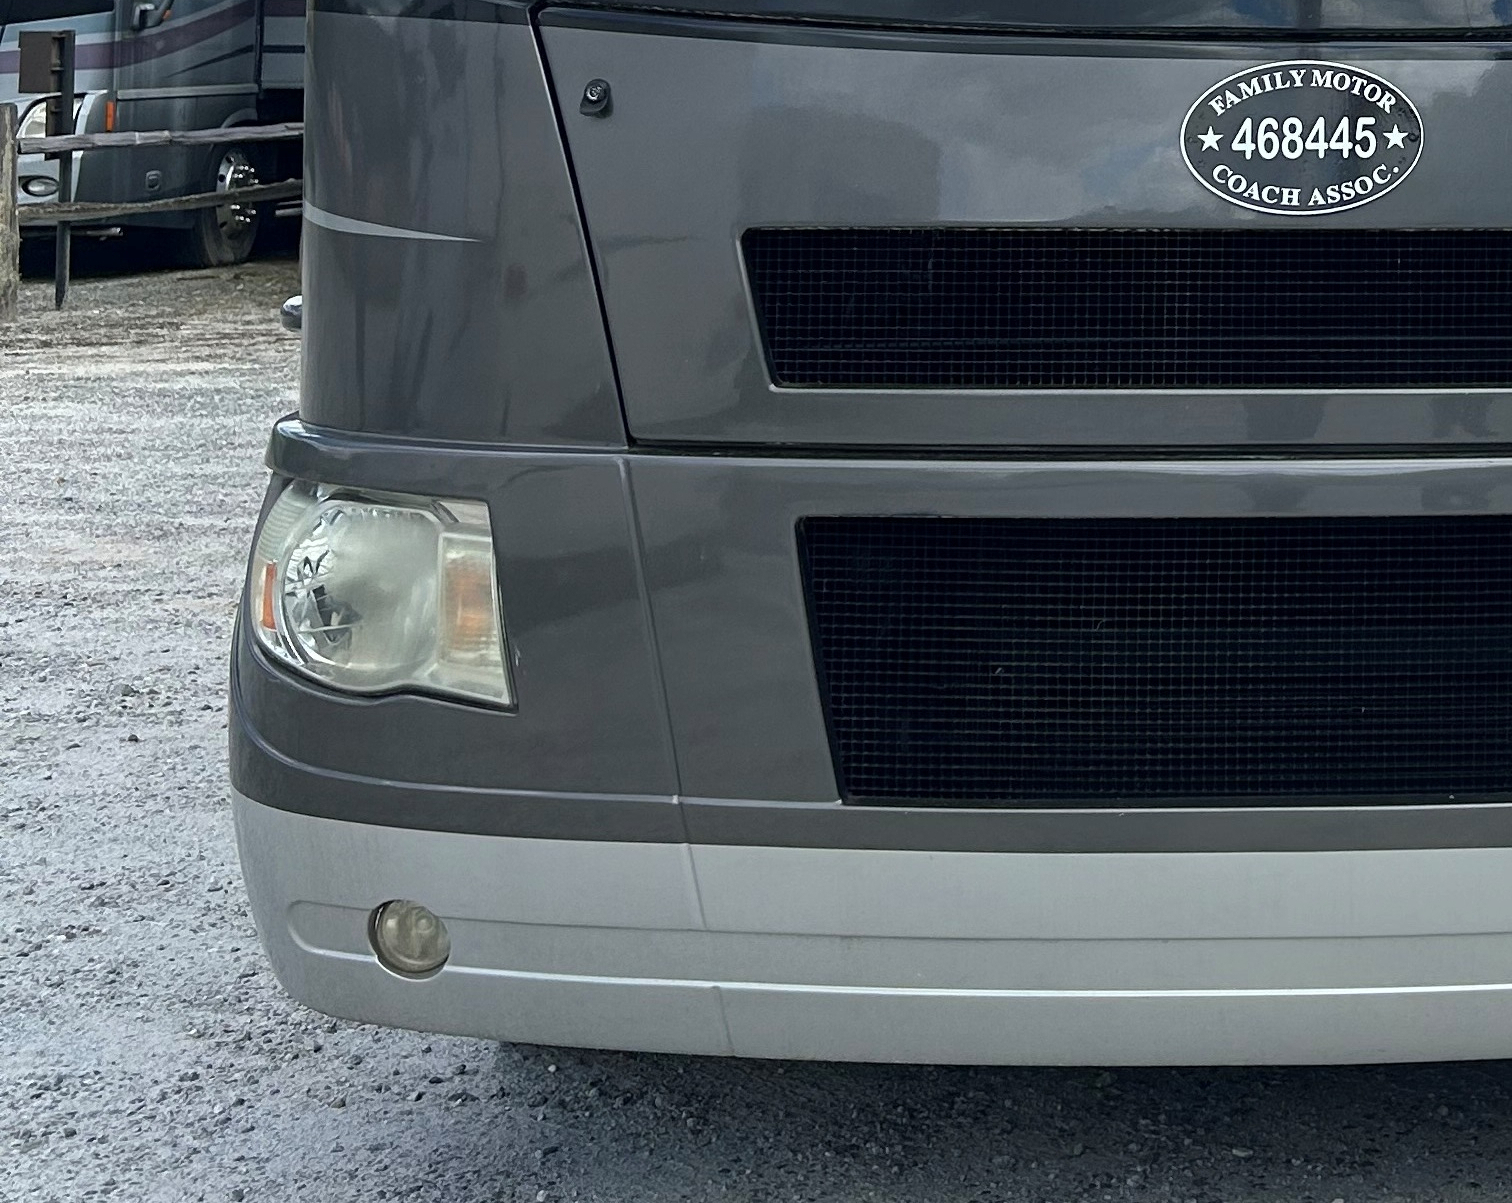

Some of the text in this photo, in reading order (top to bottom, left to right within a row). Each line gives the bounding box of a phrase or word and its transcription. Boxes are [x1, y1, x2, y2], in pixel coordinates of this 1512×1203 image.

[1208, 69, 1398, 116] FAMILY MOTOR
[1231, 116, 1377, 160] 468445
[1212, 163, 1400, 206] COACH ASSOC.
